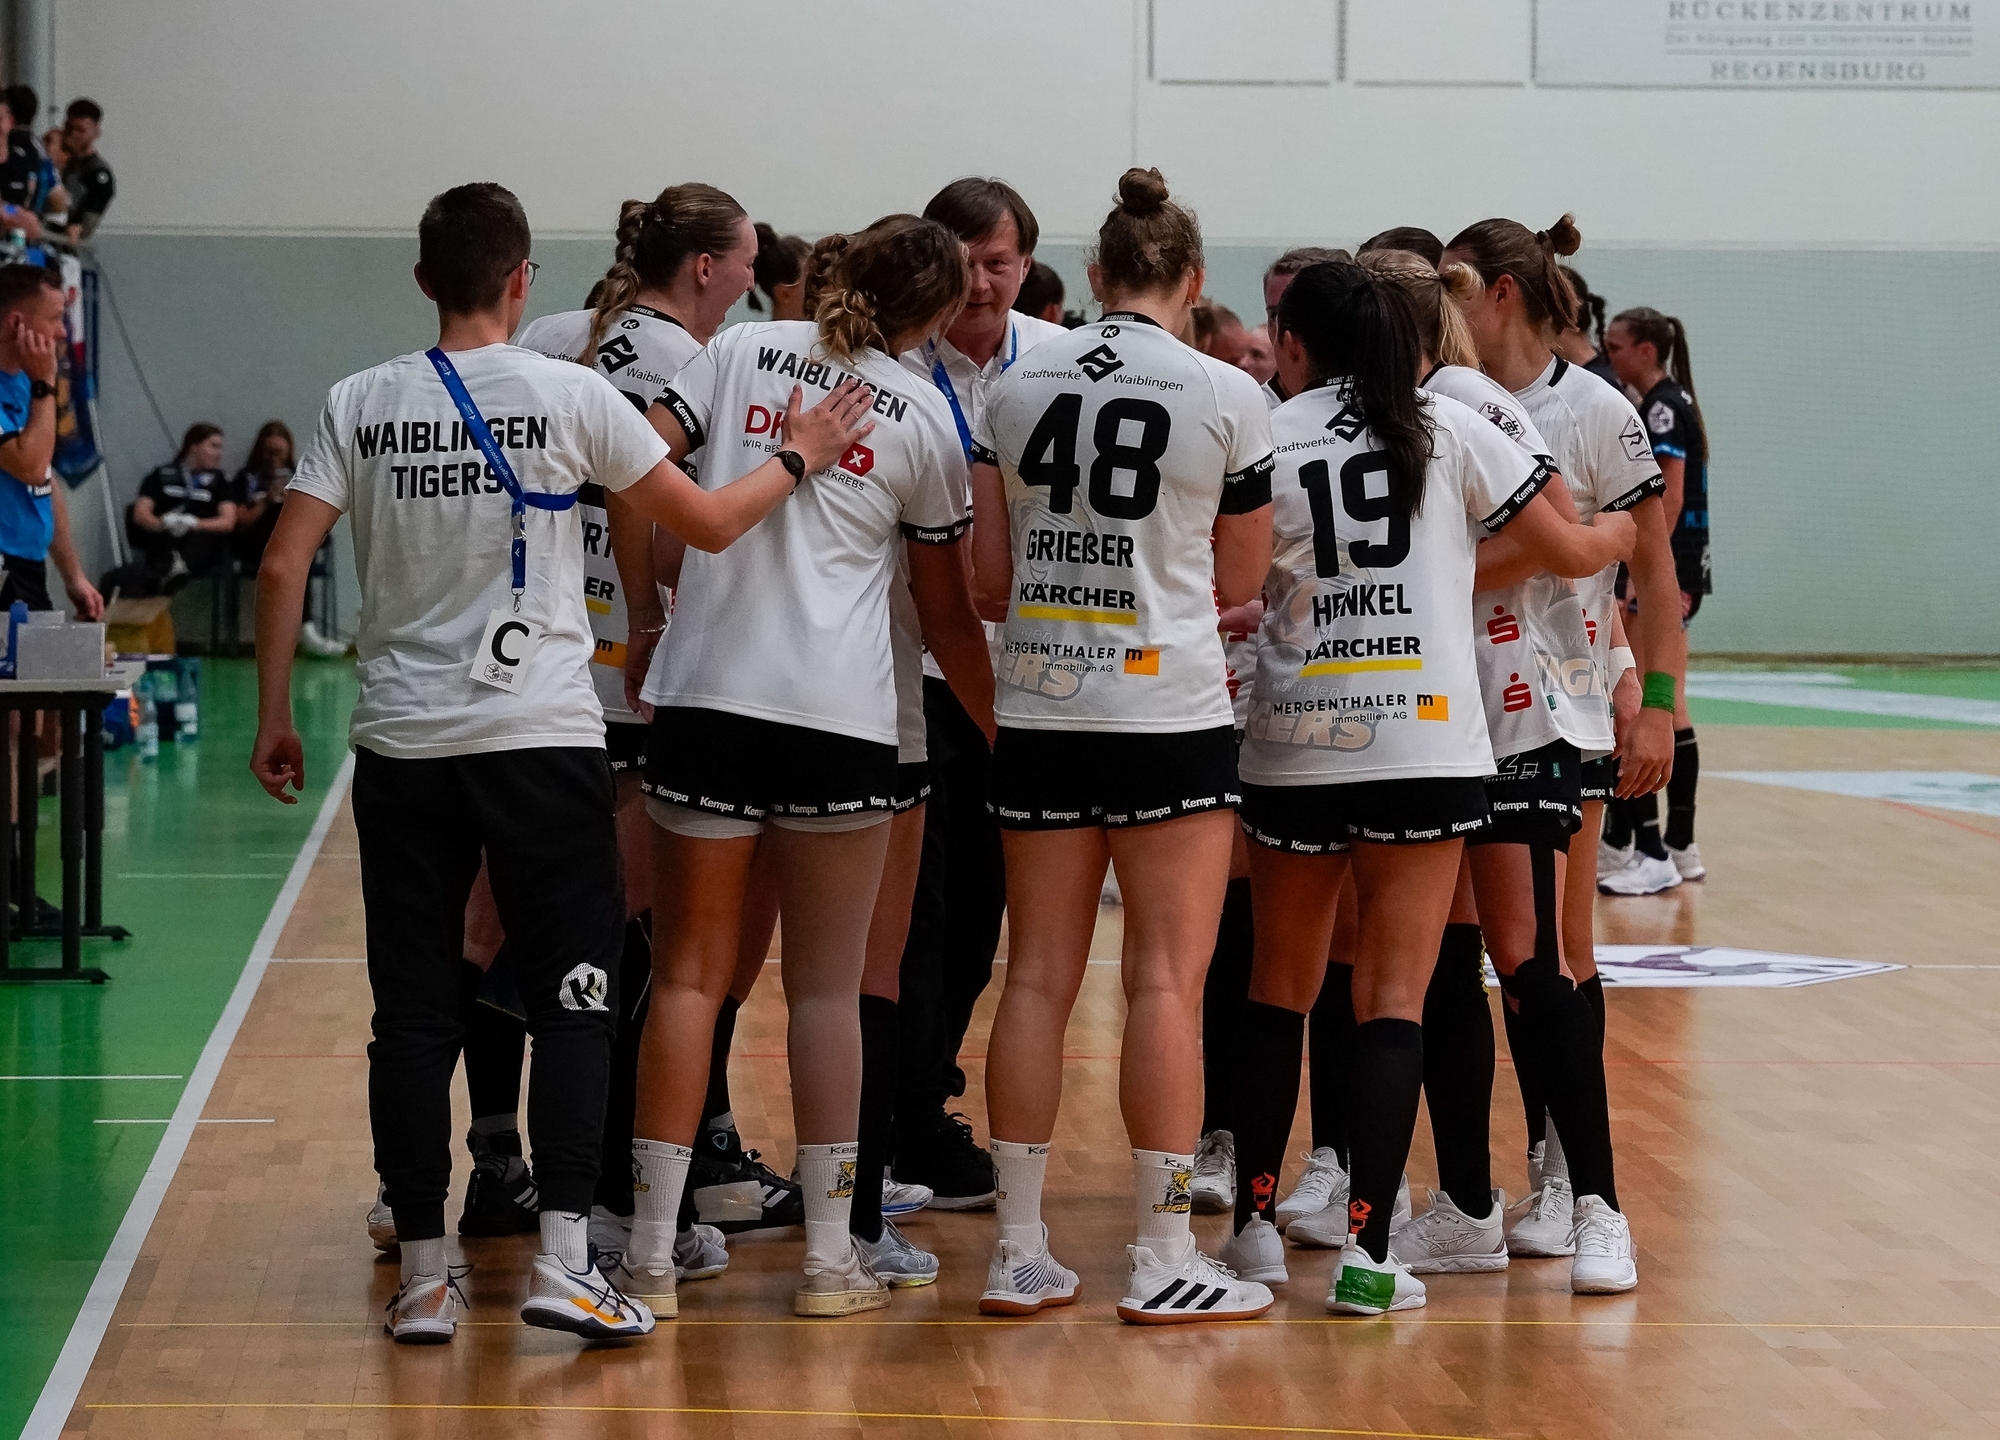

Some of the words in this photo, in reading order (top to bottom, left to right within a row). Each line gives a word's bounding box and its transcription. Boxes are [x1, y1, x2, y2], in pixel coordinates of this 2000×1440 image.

[1709, 59, 1928, 82] REGENSBURG
[1020, 369, 1082, 381] Stadtwerke
[1113, 373, 1184, 392] Waiblingen
[672, 399, 698, 434] Kempa
[742, 439, 762, 451] WIR
[1017, 392, 1172, 521] 48
[390, 461, 504, 500] TIGERS
[1484, 507, 1511, 529] Kempa
[1513, 481, 1537, 504] Kempa
[1613, 488, 1643, 511] Kempa
[1298, 449, 1411, 579] 19
[916, 529, 948, 543] Kempa
[1019, 582, 1137, 610] KÄRCHER
[491, 621, 530, 667] C
[1042, 660, 1097, 673] Immobilien
[1099, 661, 1114, 673] AG
[1273, 694, 1407, 716] MERGENTHALER
[1331, 712, 1389, 725] Immobilien
[1392, 711, 1408, 721] AG
[656, 784, 690, 803] Kempa
[700, 796, 736, 813] Kempa
[1580, 787, 1606, 799] Kempa
[789, 803, 819, 816] Kempa
[827, 799, 864, 813] Kempa
[999, 806, 1031, 821] Kempa
[1042, 810, 1081, 822] Kempa
[1135, 806, 1172, 820] Kempa
[1182, 796, 1217, 810] Kempa
[1493, 801, 1530, 812] Kempa
[1539, 799, 1568, 813] Kempa
[1256, 828, 1282, 846] Kempa
[1290, 840, 1323, 854] Kempa
[1363, 827, 1396, 842] Kempa
[1405, 828, 1442, 840] Kempa
[1451, 818, 1484, 833] Kempa
